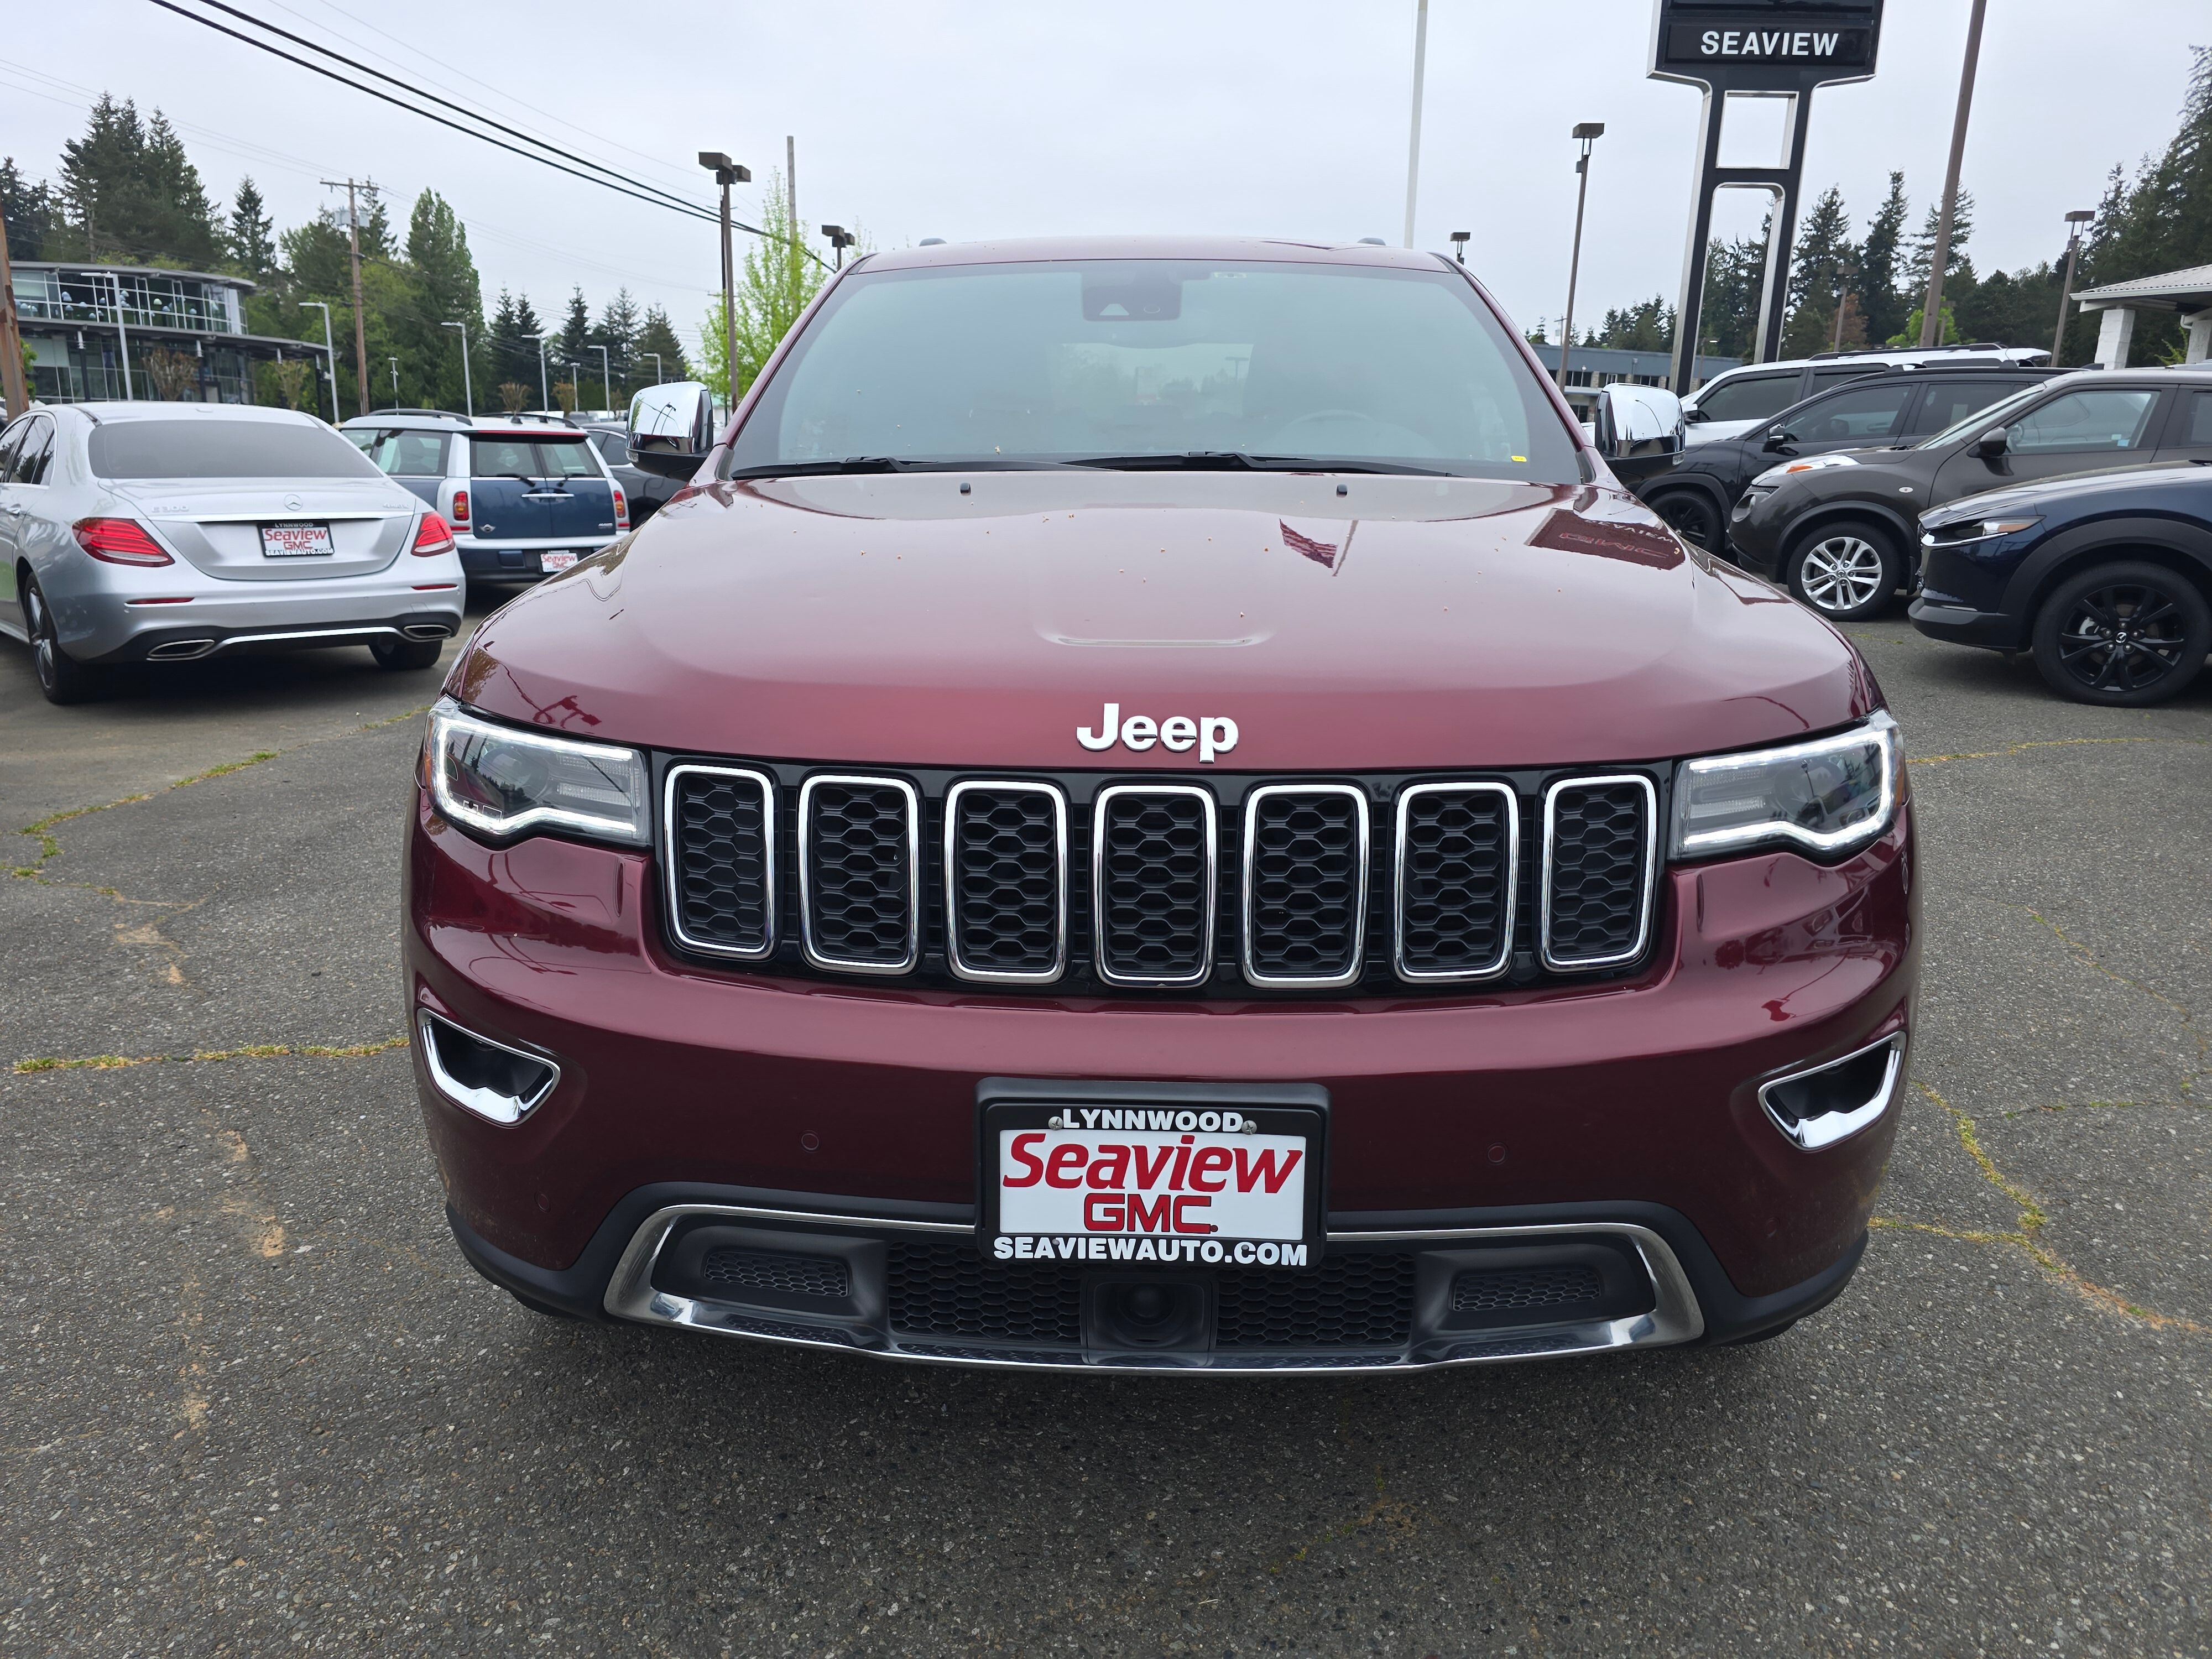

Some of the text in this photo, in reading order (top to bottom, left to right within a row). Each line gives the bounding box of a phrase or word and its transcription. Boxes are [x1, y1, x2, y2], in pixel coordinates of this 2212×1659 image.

[1700, 30, 1839, 56] SEAVIEW
[265, 528, 327, 541] Seaview
[284, 541, 314, 549] GMC
[1076, 703, 1239, 763] Jeep
[1062, 1108, 1244, 1132] LYNNWOOD
[1003, 1133, 1302, 1194] Seaview
[1083, 1193, 1213, 1234] GMC
[993, 1237, 1307, 1266] SEAVIEWAUTO.COM
